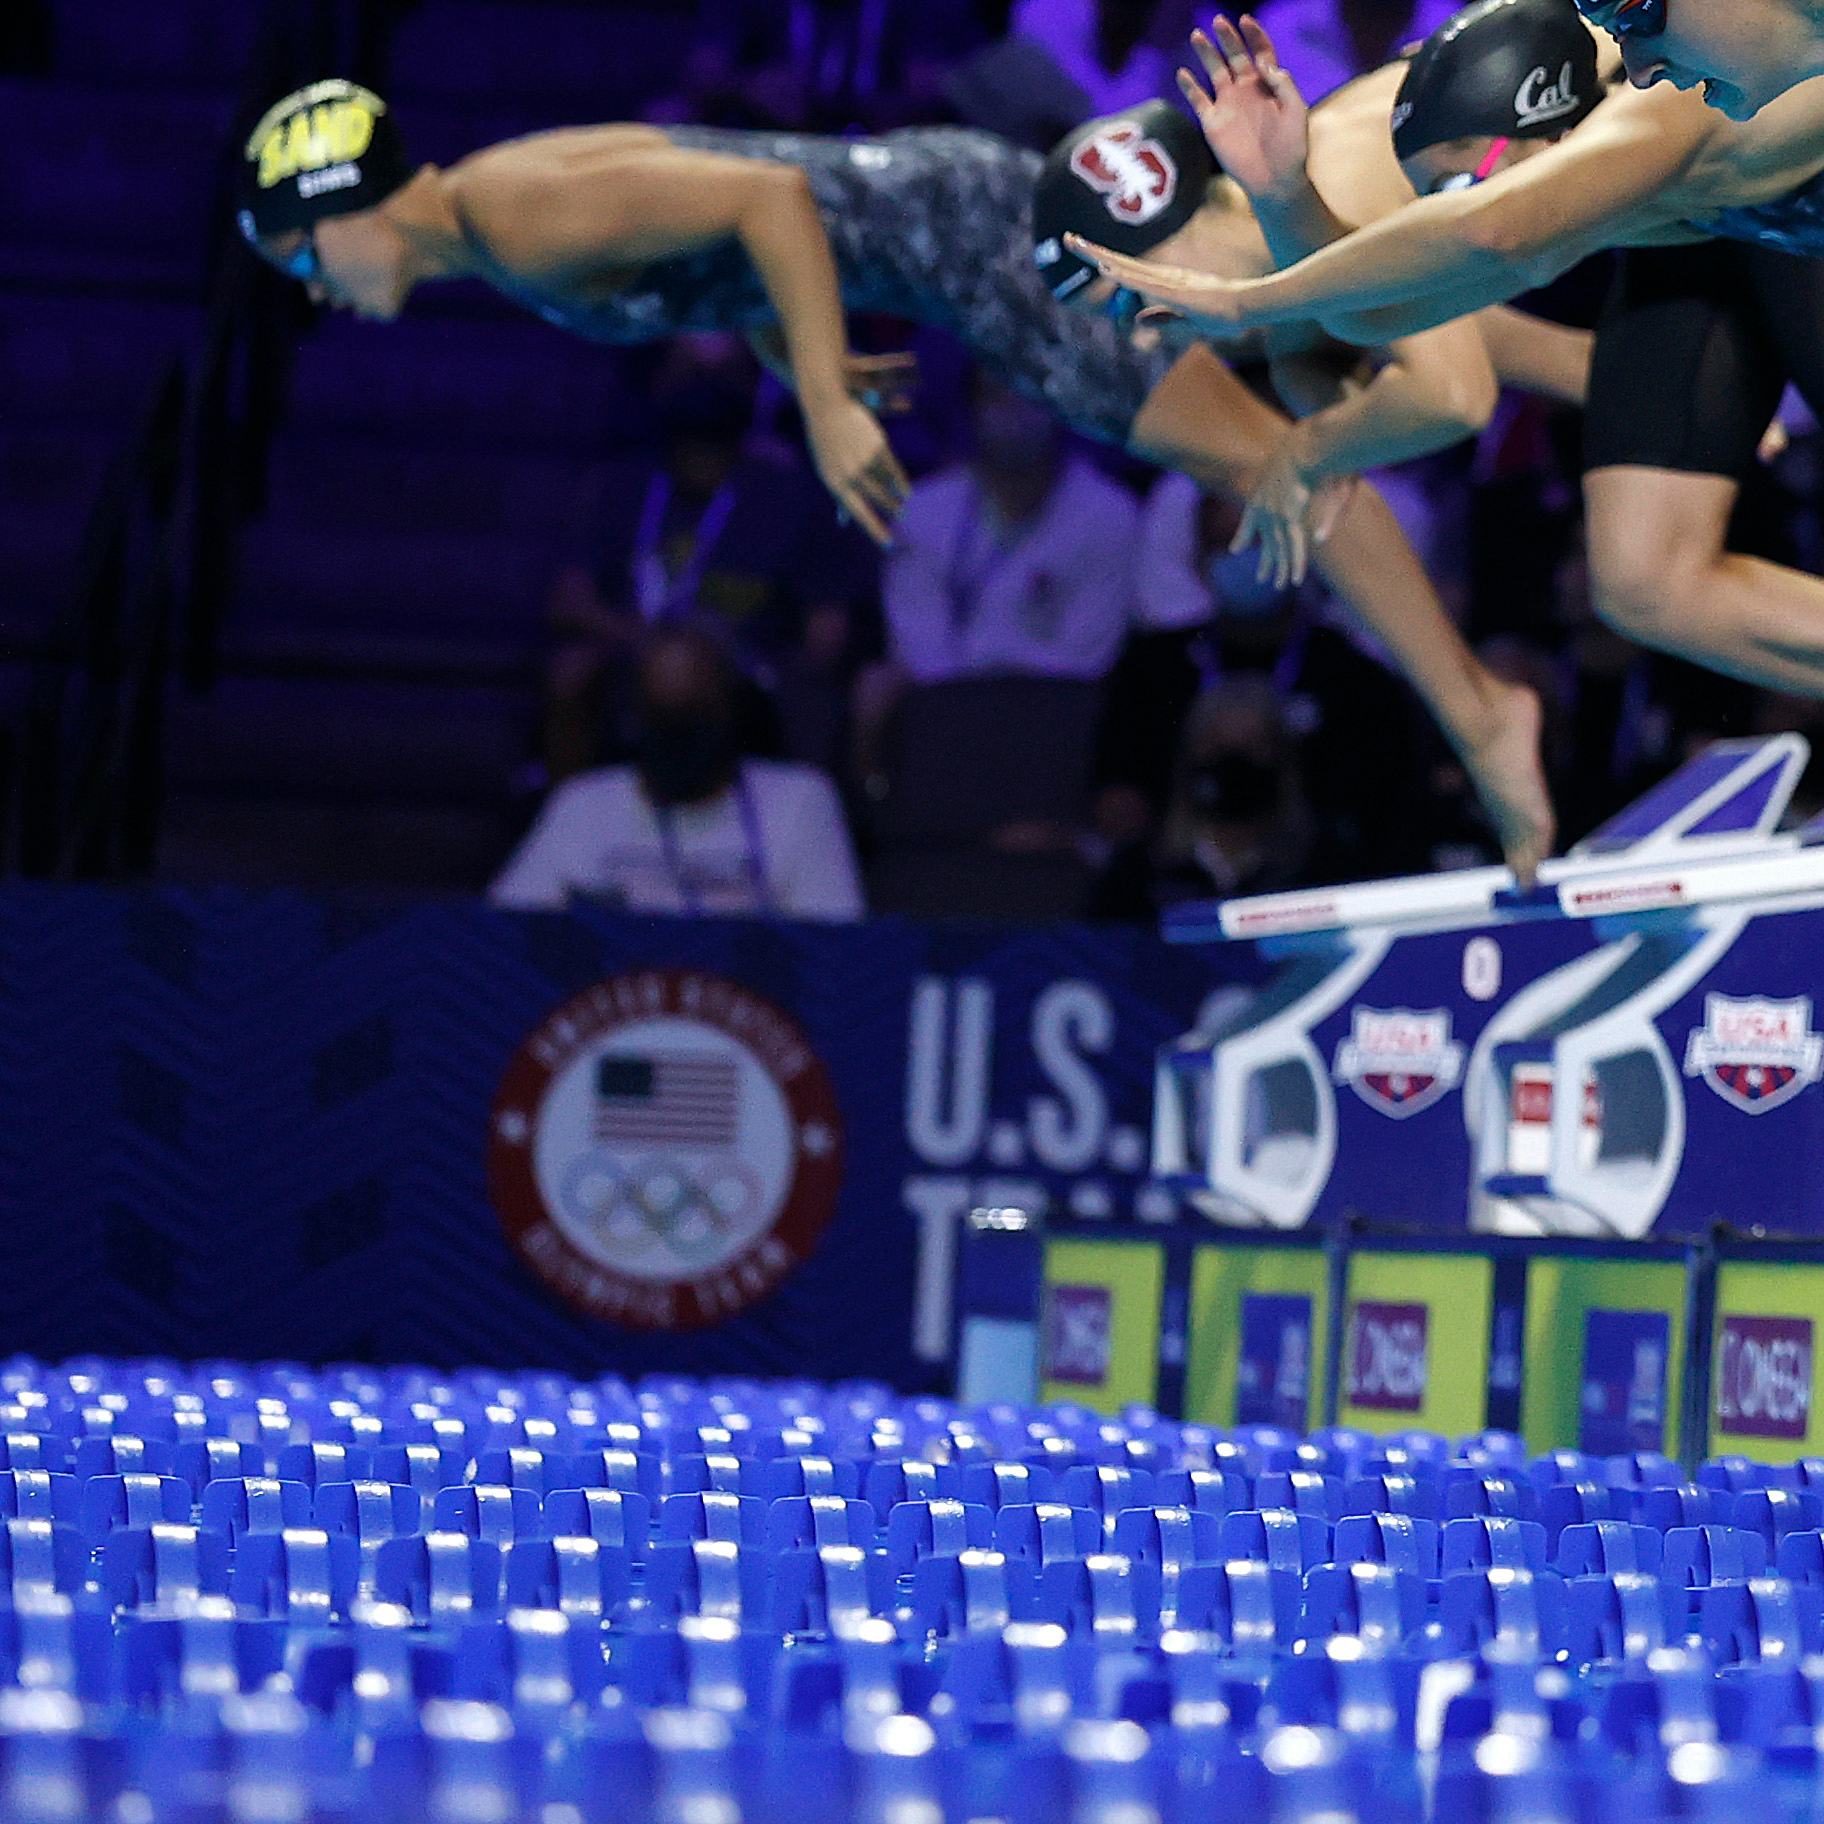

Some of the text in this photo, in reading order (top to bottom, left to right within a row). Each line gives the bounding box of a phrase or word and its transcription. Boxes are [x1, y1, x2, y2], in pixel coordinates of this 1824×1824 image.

[1514, 61, 1580, 128] Cal
[1462, 935, 1502, 1002] 0
[905, 978, 1148, 1174] U.S.
